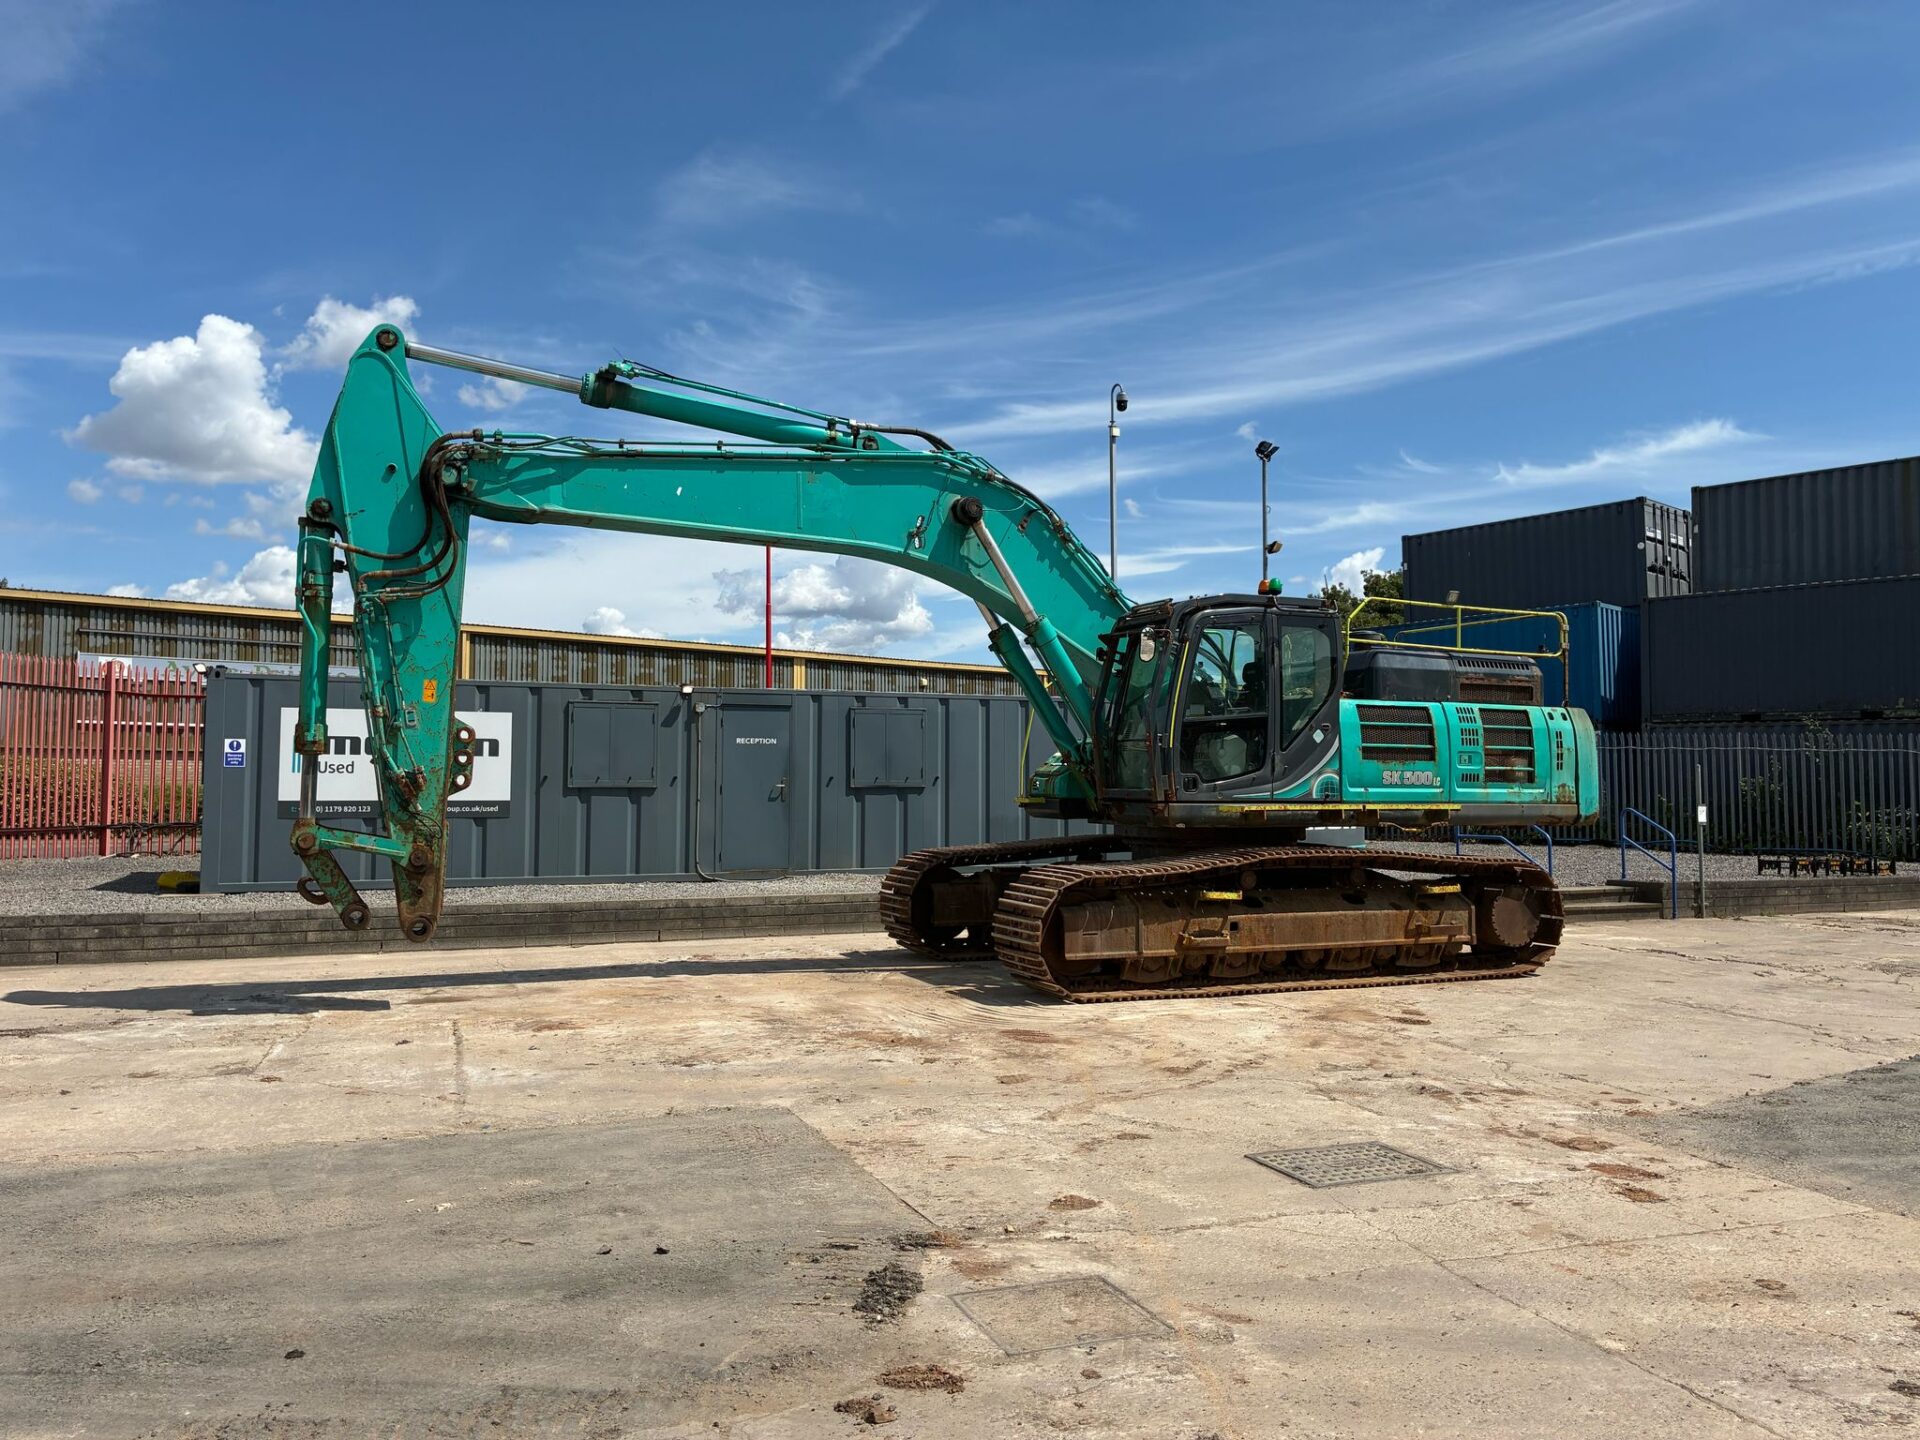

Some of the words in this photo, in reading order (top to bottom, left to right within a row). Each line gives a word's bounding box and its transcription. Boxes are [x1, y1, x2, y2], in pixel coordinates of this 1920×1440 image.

[736, 737, 777, 745] RECEPTION
[317, 760, 355, 773] Used
[1382, 770, 1401, 785] SK
[1403, 770, 1433, 786] 500
[447, 805, 499, 814] oup.co.uk/used
